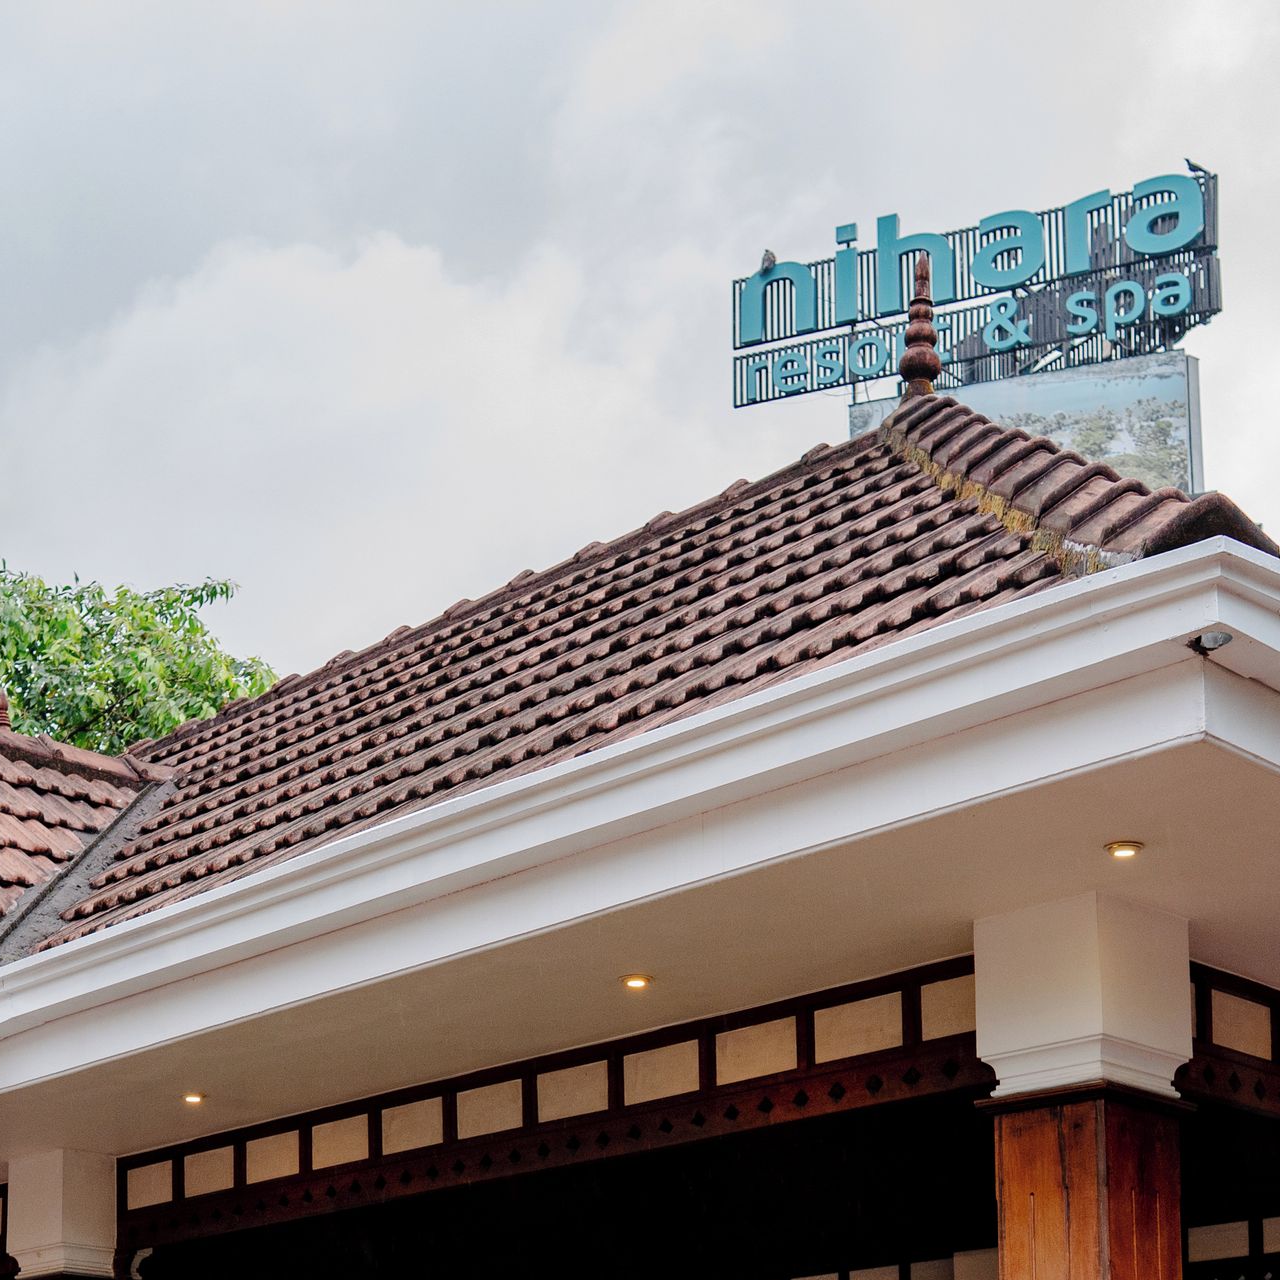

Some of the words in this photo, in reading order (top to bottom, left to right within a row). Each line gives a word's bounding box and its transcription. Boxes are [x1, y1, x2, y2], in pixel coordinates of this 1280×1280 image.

[740, 174, 1205, 345] nihara
[983, 297, 1032, 351] &
[1066, 272, 1192, 342] spa
